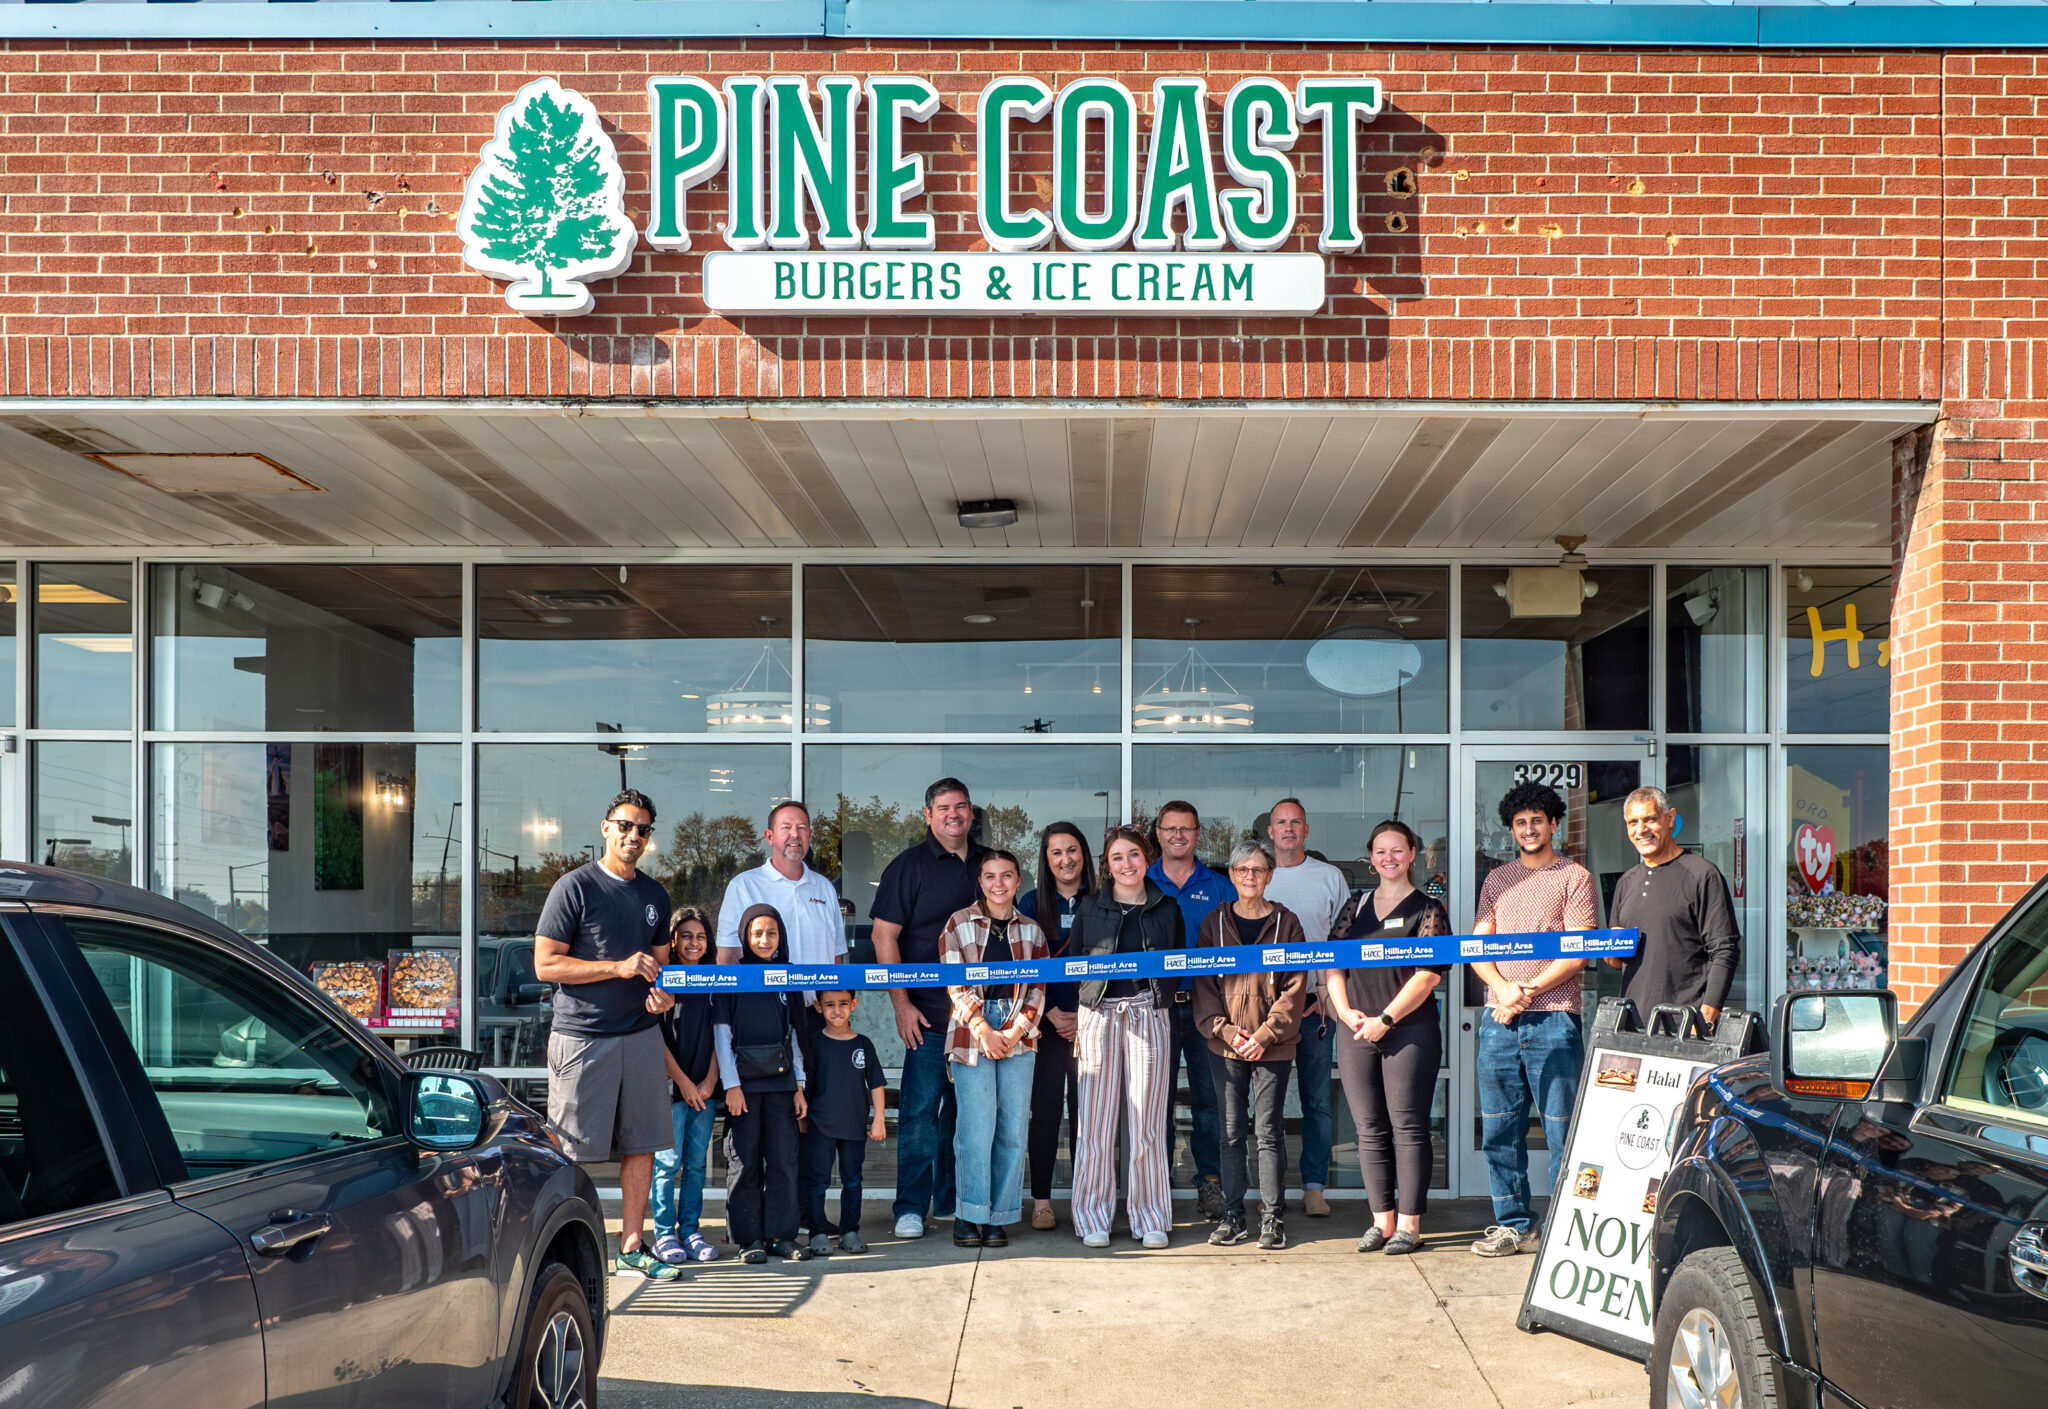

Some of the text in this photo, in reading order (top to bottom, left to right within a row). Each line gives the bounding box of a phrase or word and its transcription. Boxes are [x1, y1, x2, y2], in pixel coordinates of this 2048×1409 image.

[653, 82, 1376, 242] PINE COAST
[775, 261, 1254, 301] BURGERS & ICE CREAM
[1514, 764, 1581, 789] 3229
[1800, 828, 1831, 882] ty
[1484, 942, 1511, 950] Hilliard
[1585, 938, 1612, 947] Hilliard
[1286, 951, 1313, 959] Hilliard
[1385, 947, 1412, 955] Hilliard
[1089, 962, 1116, 970] Hilliard
[1188, 956, 1214, 964] Hilliard
[687, 974, 715, 982] Hilliard
[1647, 1069, 1681, 1089] Halal
[1619, 1132, 1661, 1151] PINE COAST
[1549, 1259, 1652, 1327] OPEN
